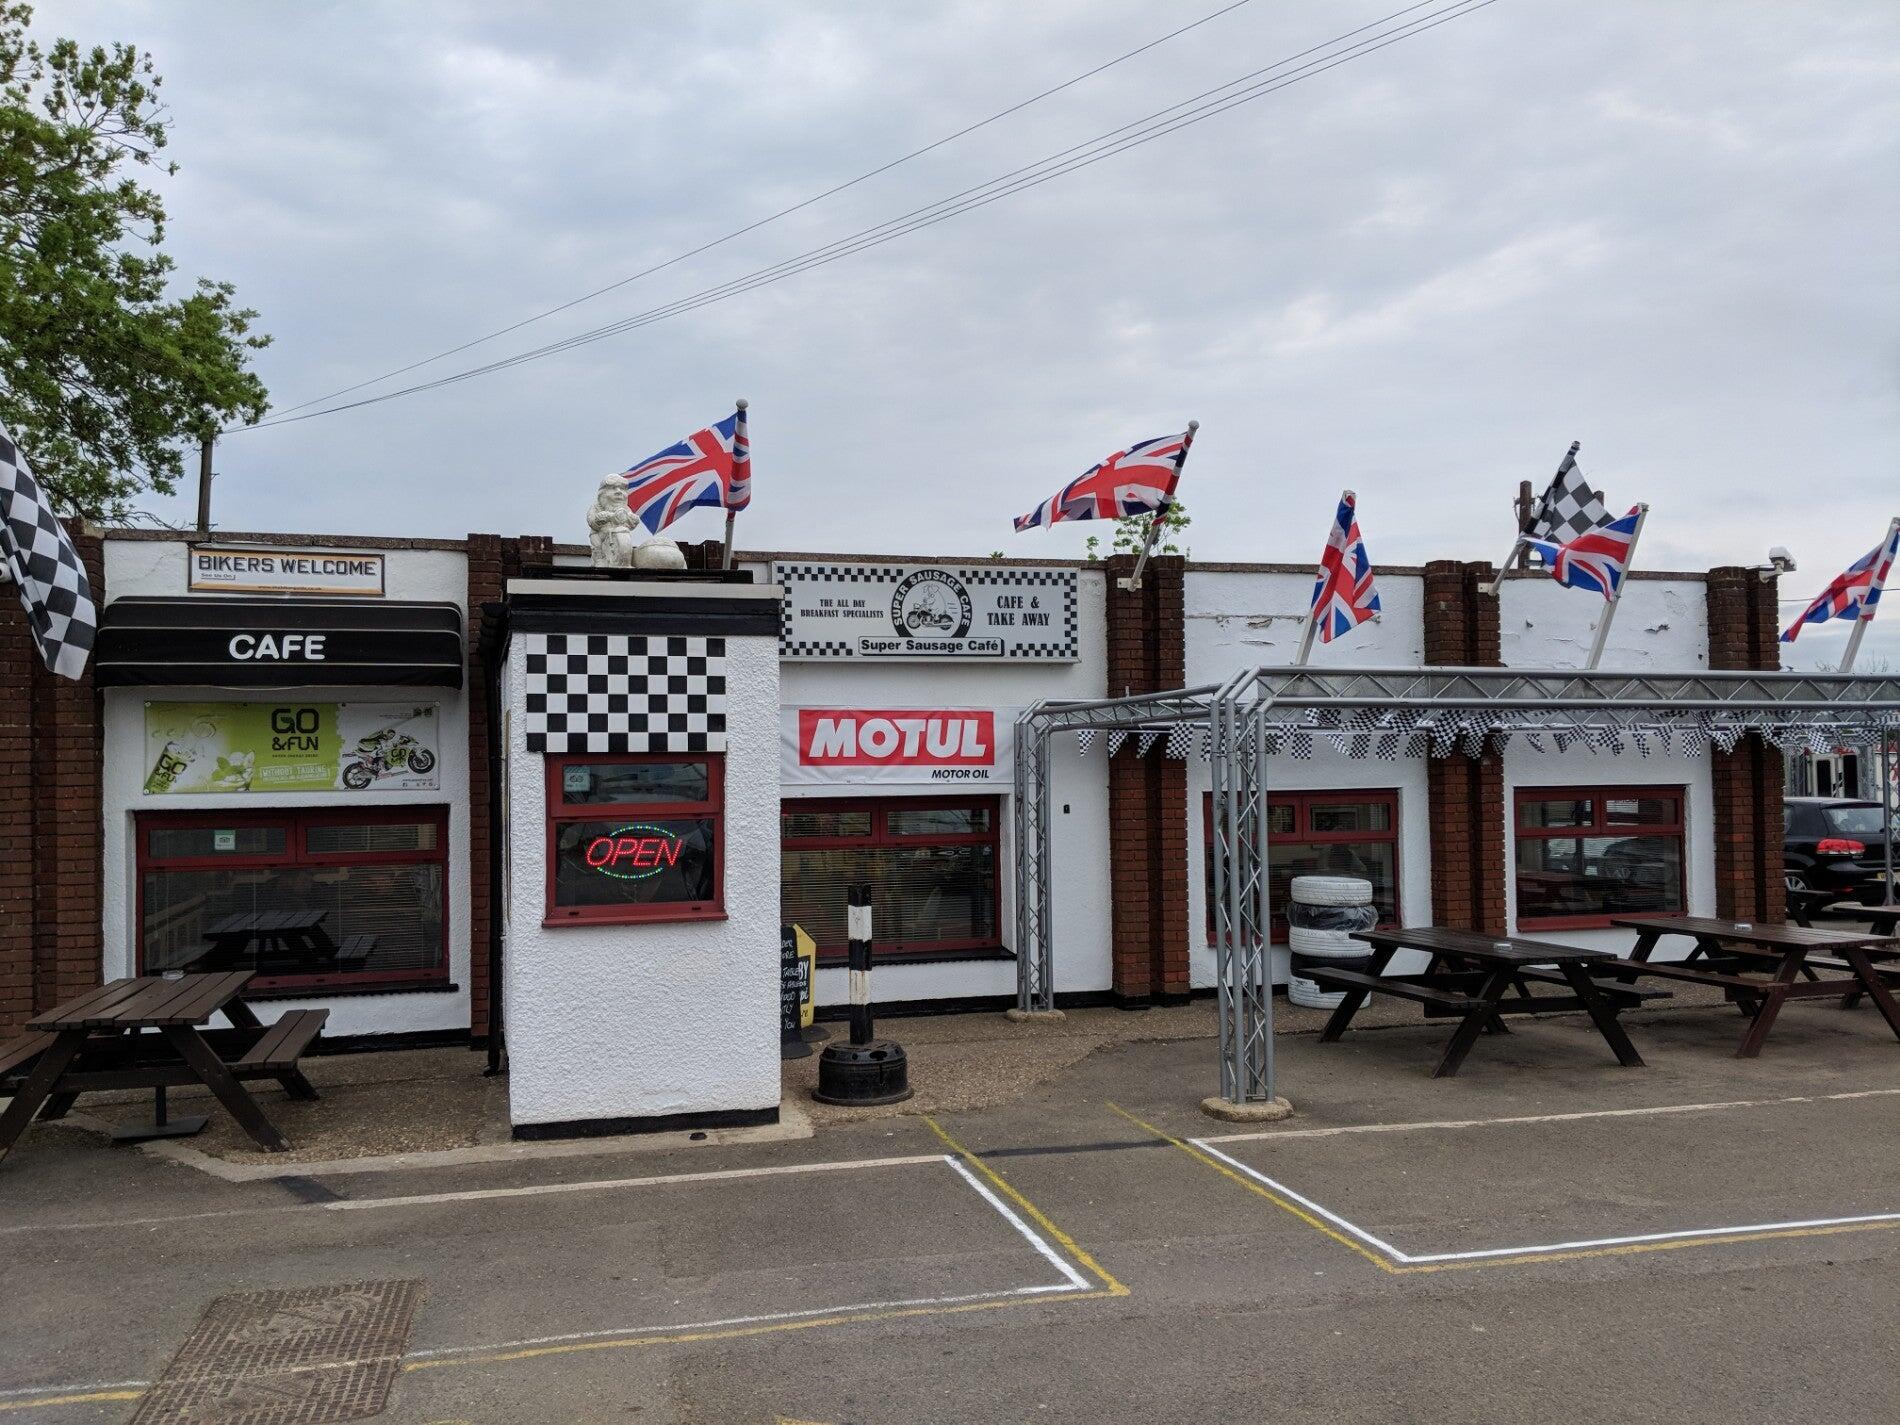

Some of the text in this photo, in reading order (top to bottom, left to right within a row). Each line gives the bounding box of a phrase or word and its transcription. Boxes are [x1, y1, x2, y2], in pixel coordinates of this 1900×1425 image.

[198, 555, 378, 577] BIKERS WELCOME
[820, 599, 866, 608] THE ALL DAY
[893, 571, 971, 627] SUPER SAUSAGE CAFE
[996, 596, 1040, 609] CAFE &
[800, 609, 884, 619] BREAKFAST SPECIALISTS
[987, 613, 1050, 626] TAKE AWAY
[228, 634, 327, 660] CAFE
[861, 639, 999, 654] Super Sausage Café
[271, 708, 319, 734] GO
[272, 736, 319, 751] &FUN
[808, 718, 987, 758] MOTUL
[160, 754, 187, 774] GO
[931, 769, 990, 779] MOTOR OIL
[585, 837, 683, 867] OPEN
